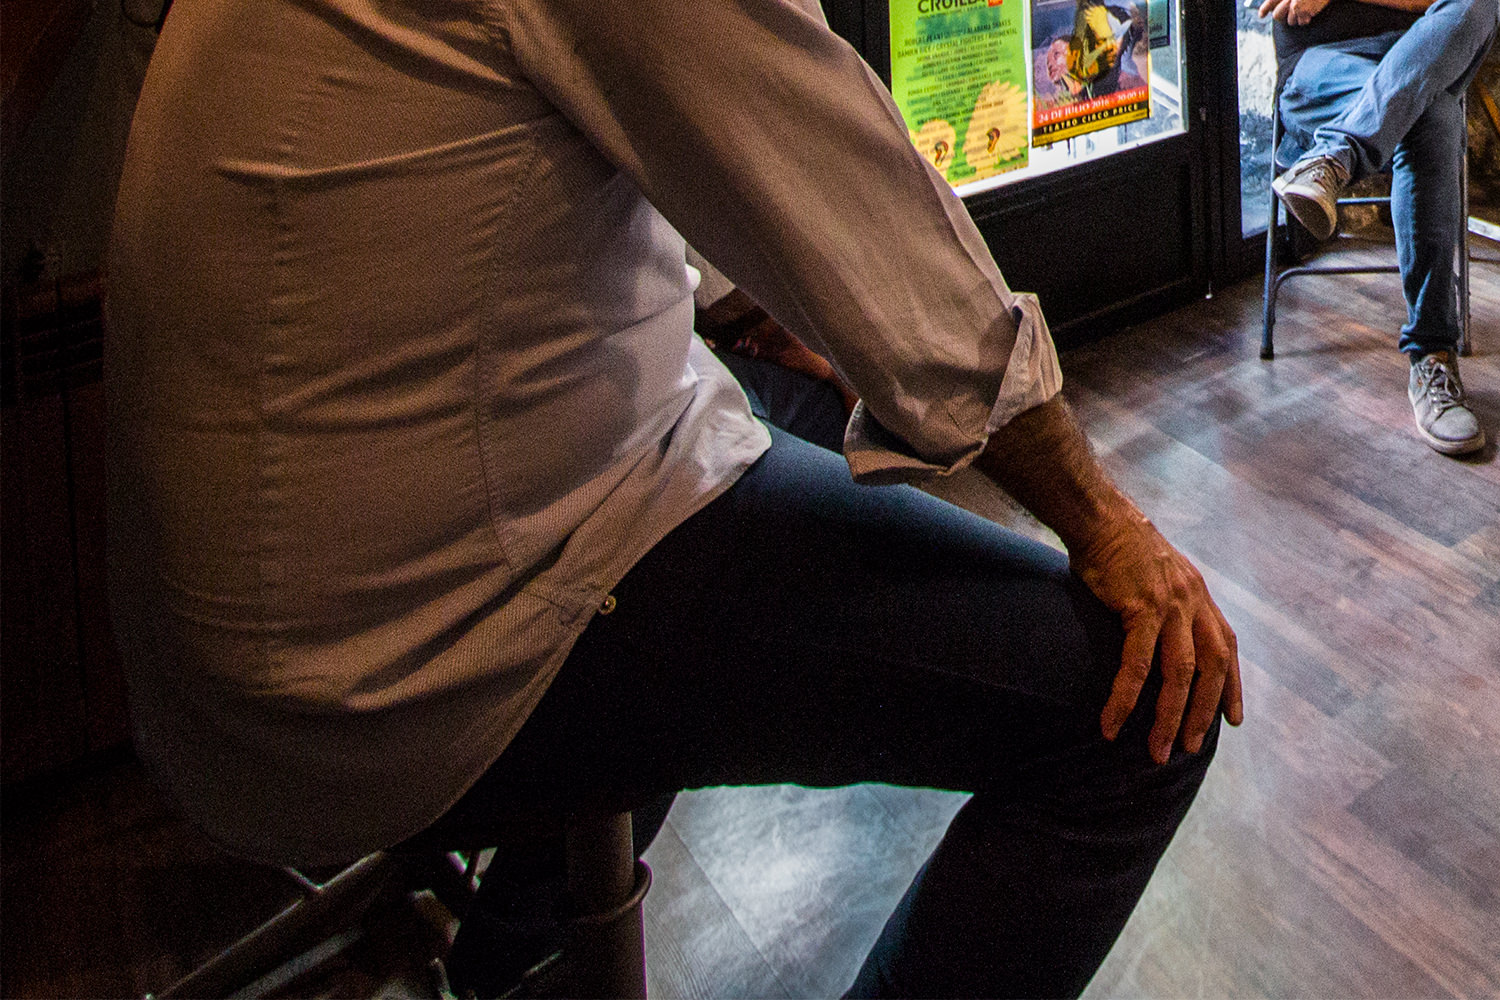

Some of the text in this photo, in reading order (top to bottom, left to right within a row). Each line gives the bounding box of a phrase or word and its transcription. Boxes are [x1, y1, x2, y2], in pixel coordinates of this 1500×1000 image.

[1043, 118, 1078, 133] TEATRO
[1081, 110, 1109, 124] CIRCO
[1113, 103, 1139, 116] PRICE
[1065, 102, 1090, 117] JULIO
